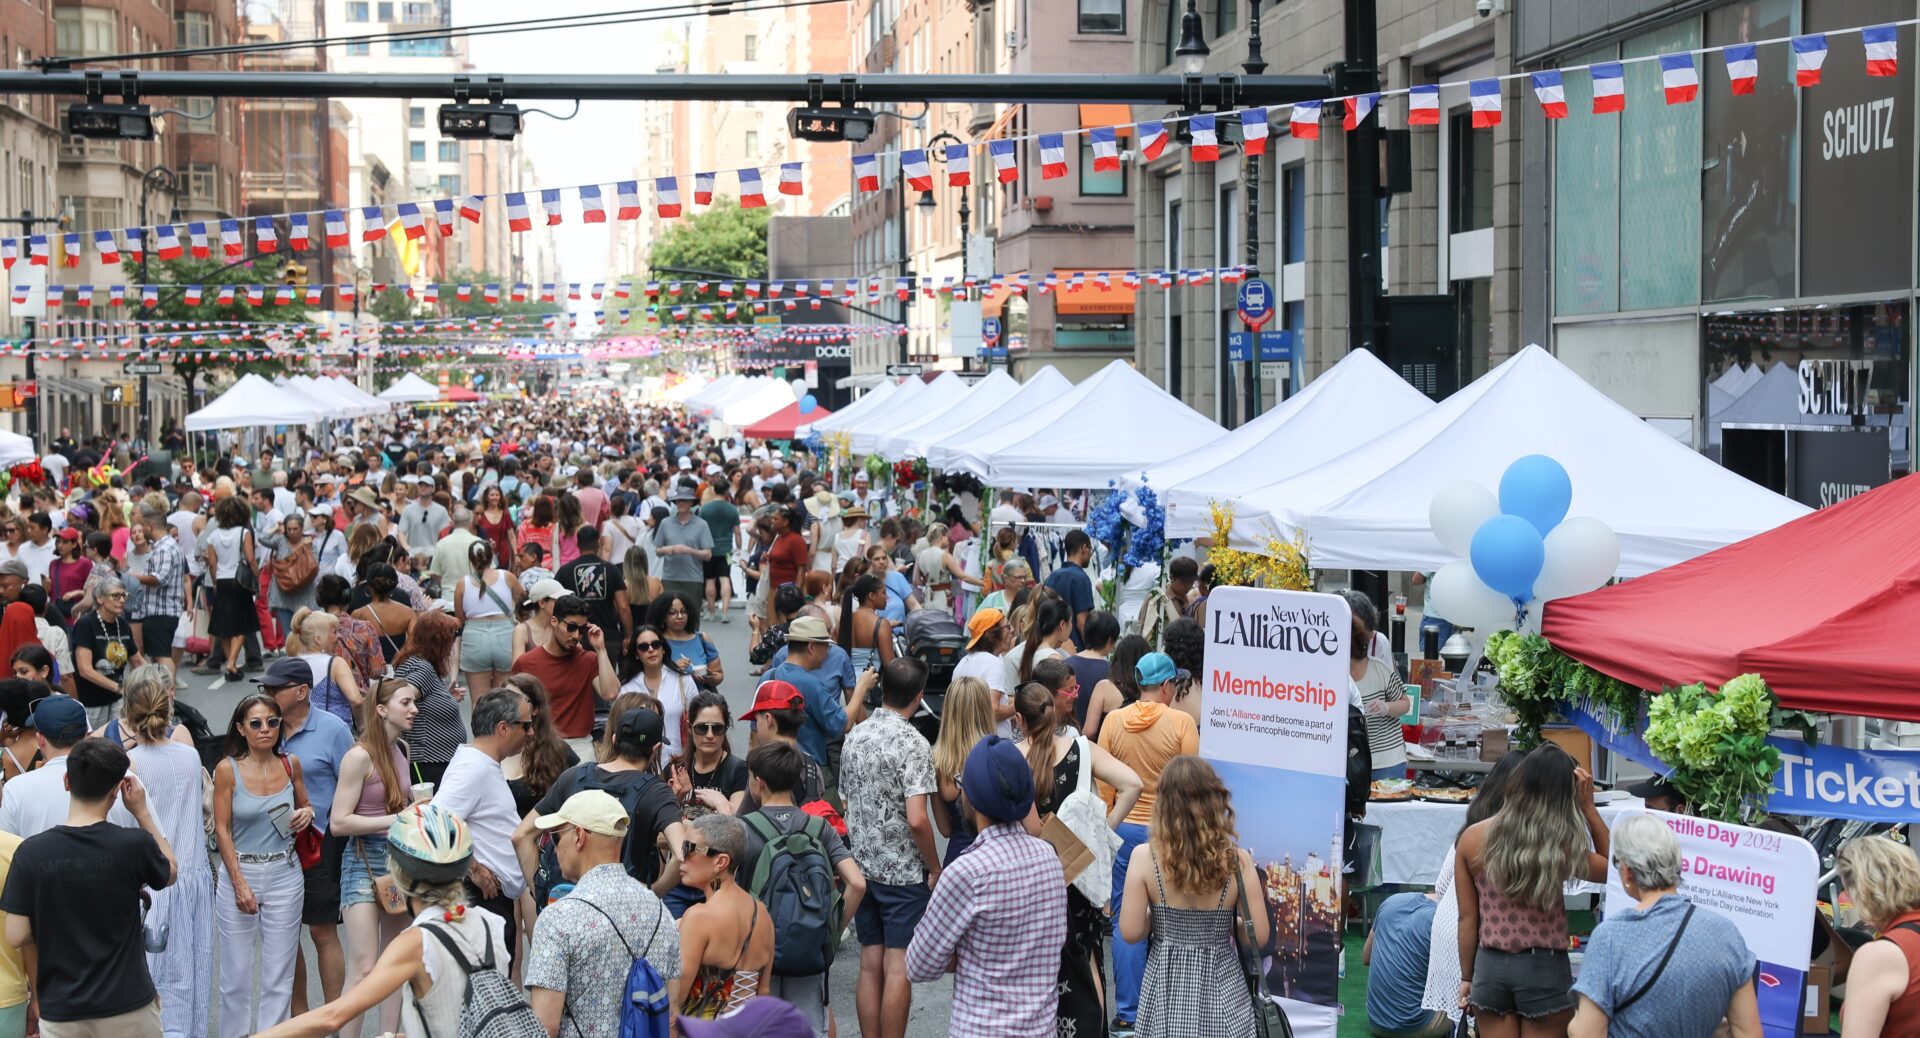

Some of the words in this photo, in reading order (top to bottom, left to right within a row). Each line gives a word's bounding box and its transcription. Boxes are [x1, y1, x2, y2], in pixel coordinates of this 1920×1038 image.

[1823, 97, 1894, 161] SCHUTZ
[815, 346, 851, 358] DOLCE
[1229, 335, 1242, 346] M3
[1230, 349, 1242, 359] M4
[1798, 359, 1874, 416] SCHUTZ
[1820, 482, 1871, 510] SCH
[1271, 605, 1299, 623] New
[1301, 608, 1330, 627] York
[1213, 610, 1339, 656] L'Alliance
[1213, 669, 1337, 712] Membership
[1210, 706, 1226, 717] Join
[1226, 709, 1261, 721] L'Alliance
[1261, 713, 1275, 723] and
[1276, 715, 1304, 727] become
[1310, 719, 1326, 731] part
[1326, 721, 1334, 730] of
[1210, 719, 1227, 729] New
[1227, 719, 1249, 732] York's
[1249, 723, 1290, 738] Francophile
[1290, 729, 1332, 744] community!
[1778, 753, 1920, 809] Ticket
[1666, 818, 1705, 838] stille
[1707, 823, 1740, 848] Day
[1743, 831, 1782, 853] 2024
[1694, 856, 1776, 895] Drawing
[1693, 895, 1718, 908] Bastille
[1719, 901, 1734, 912] Day
[1734, 905, 1775, 919] celebration.
[1698, 888, 1710, 897] any
[1711, 888, 1745, 902] L'Alliance
[1745, 896, 1763, 906] New
[1763, 899, 1780, 909] York
[1057, 980, 1071, 995] OK
[1056, 1017, 1077, 1030] OOK
